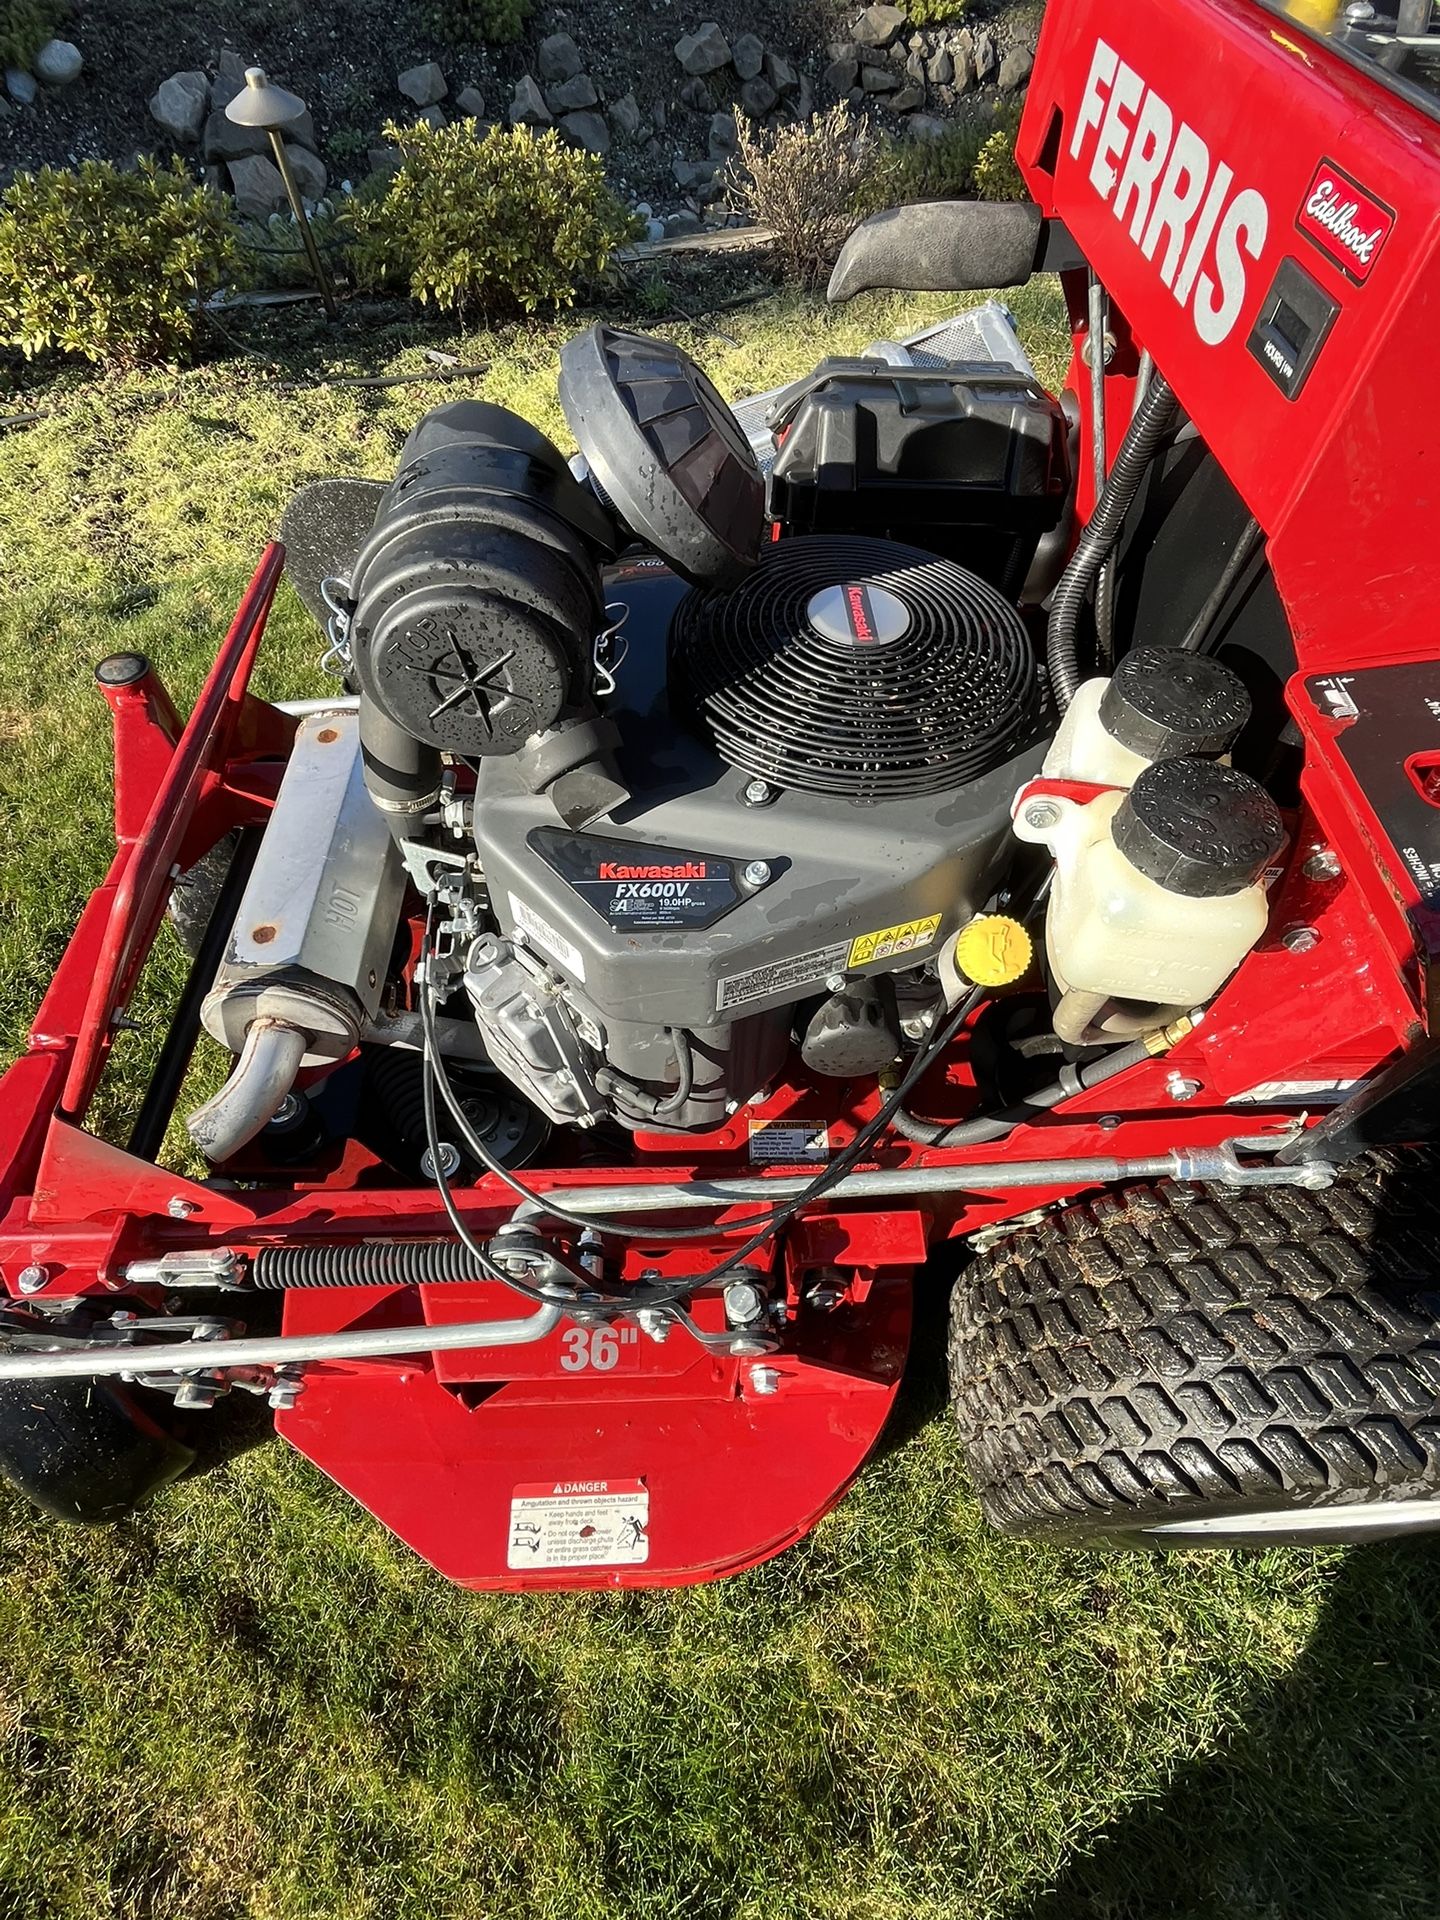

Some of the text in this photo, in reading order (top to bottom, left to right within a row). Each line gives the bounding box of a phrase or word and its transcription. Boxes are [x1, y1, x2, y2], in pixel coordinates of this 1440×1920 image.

[1069, 37, 1268, 346] FERRIS
[1306, 180, 1383, 264] Edelbrock
[847, 586, 873, 642] Kawasaki
[386, 616, 441, 664] TOP
[600, 861, 706, 879] Kawasaki
[1403, 847, 1431, 880] INCHES
[325, 887, 361, 933] HOT
[615, 883, 690, 898] FX600V
[560, 1326, 637, 1371] 36"
[521, 1500, 557, 1508] Amputation
[593, 1496, 616, 1505] objects
[617, 1495, 638, 1503] hazard
[564, 1482, 608, 1494] DANGER
[568, 1554, 587, 1562] proper
